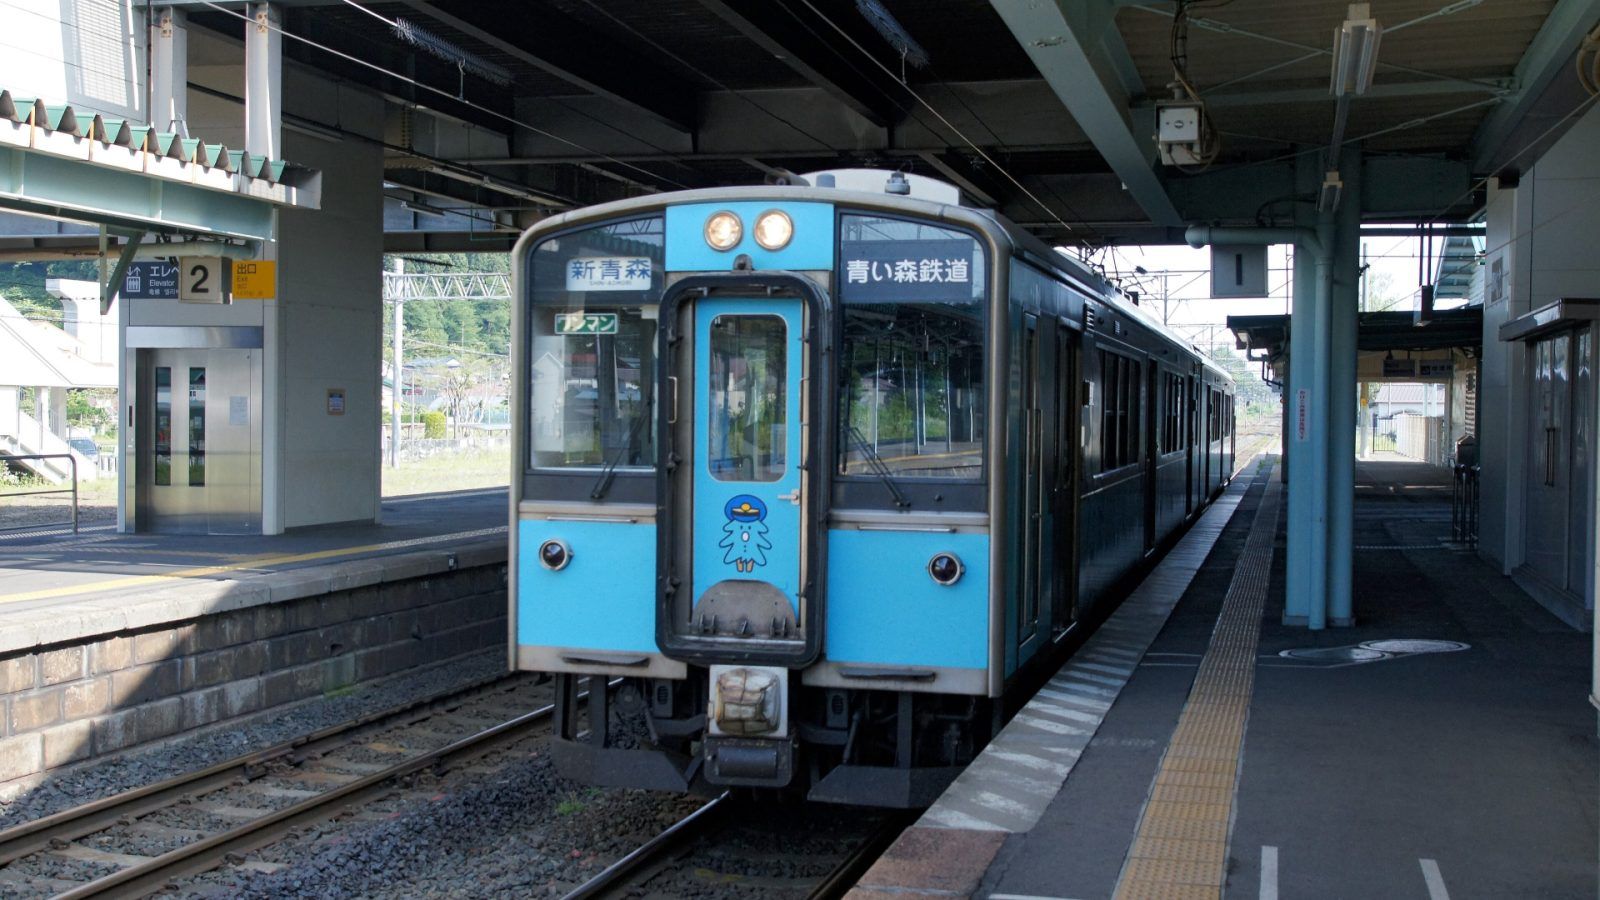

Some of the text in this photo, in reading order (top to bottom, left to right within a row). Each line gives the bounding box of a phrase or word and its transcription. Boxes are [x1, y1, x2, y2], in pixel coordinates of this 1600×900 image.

[190, 264, 209, 293] 2
[236, 263, 257, 275] 出口
[571, 259, 651, 280] 新青森
[847, 258, 969, 284] 青い森鉄道
[149, 279, 175, 287] Elevator
[557, 315, 615, 333] ワンマン
